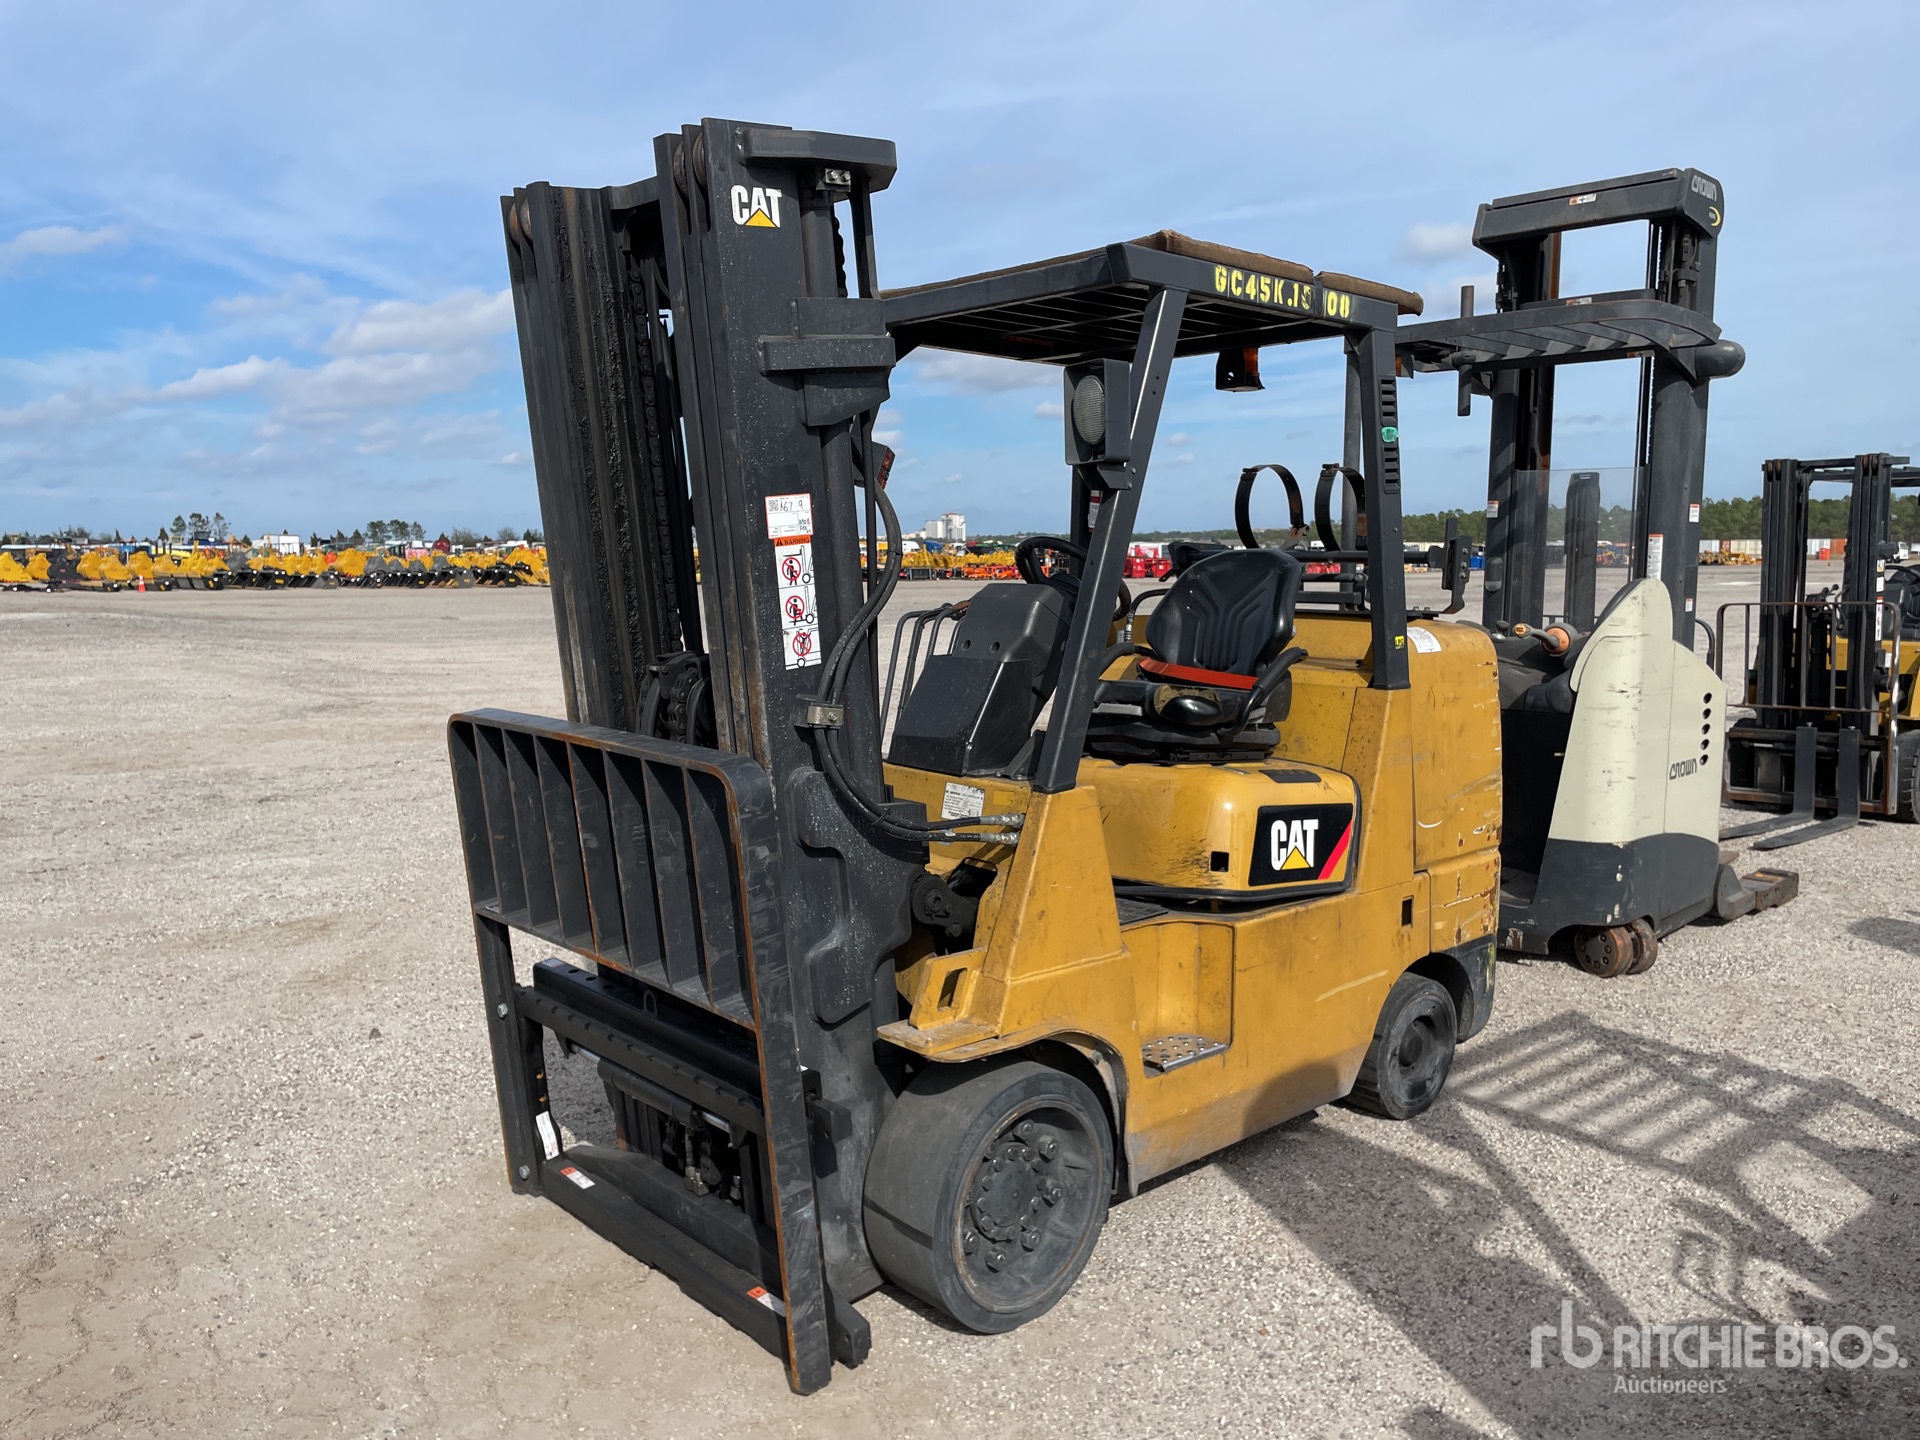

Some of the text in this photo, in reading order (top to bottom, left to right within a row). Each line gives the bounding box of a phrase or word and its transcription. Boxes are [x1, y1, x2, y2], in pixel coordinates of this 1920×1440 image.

[1691, 174, 1717, 202] CROWN
[731, 185, 782, 228] CAT
[783, 537, 810, 545] WARNING
[1669, 758, 1697, 780] CROWN
[1270, 819, 1319, 871] CAT
